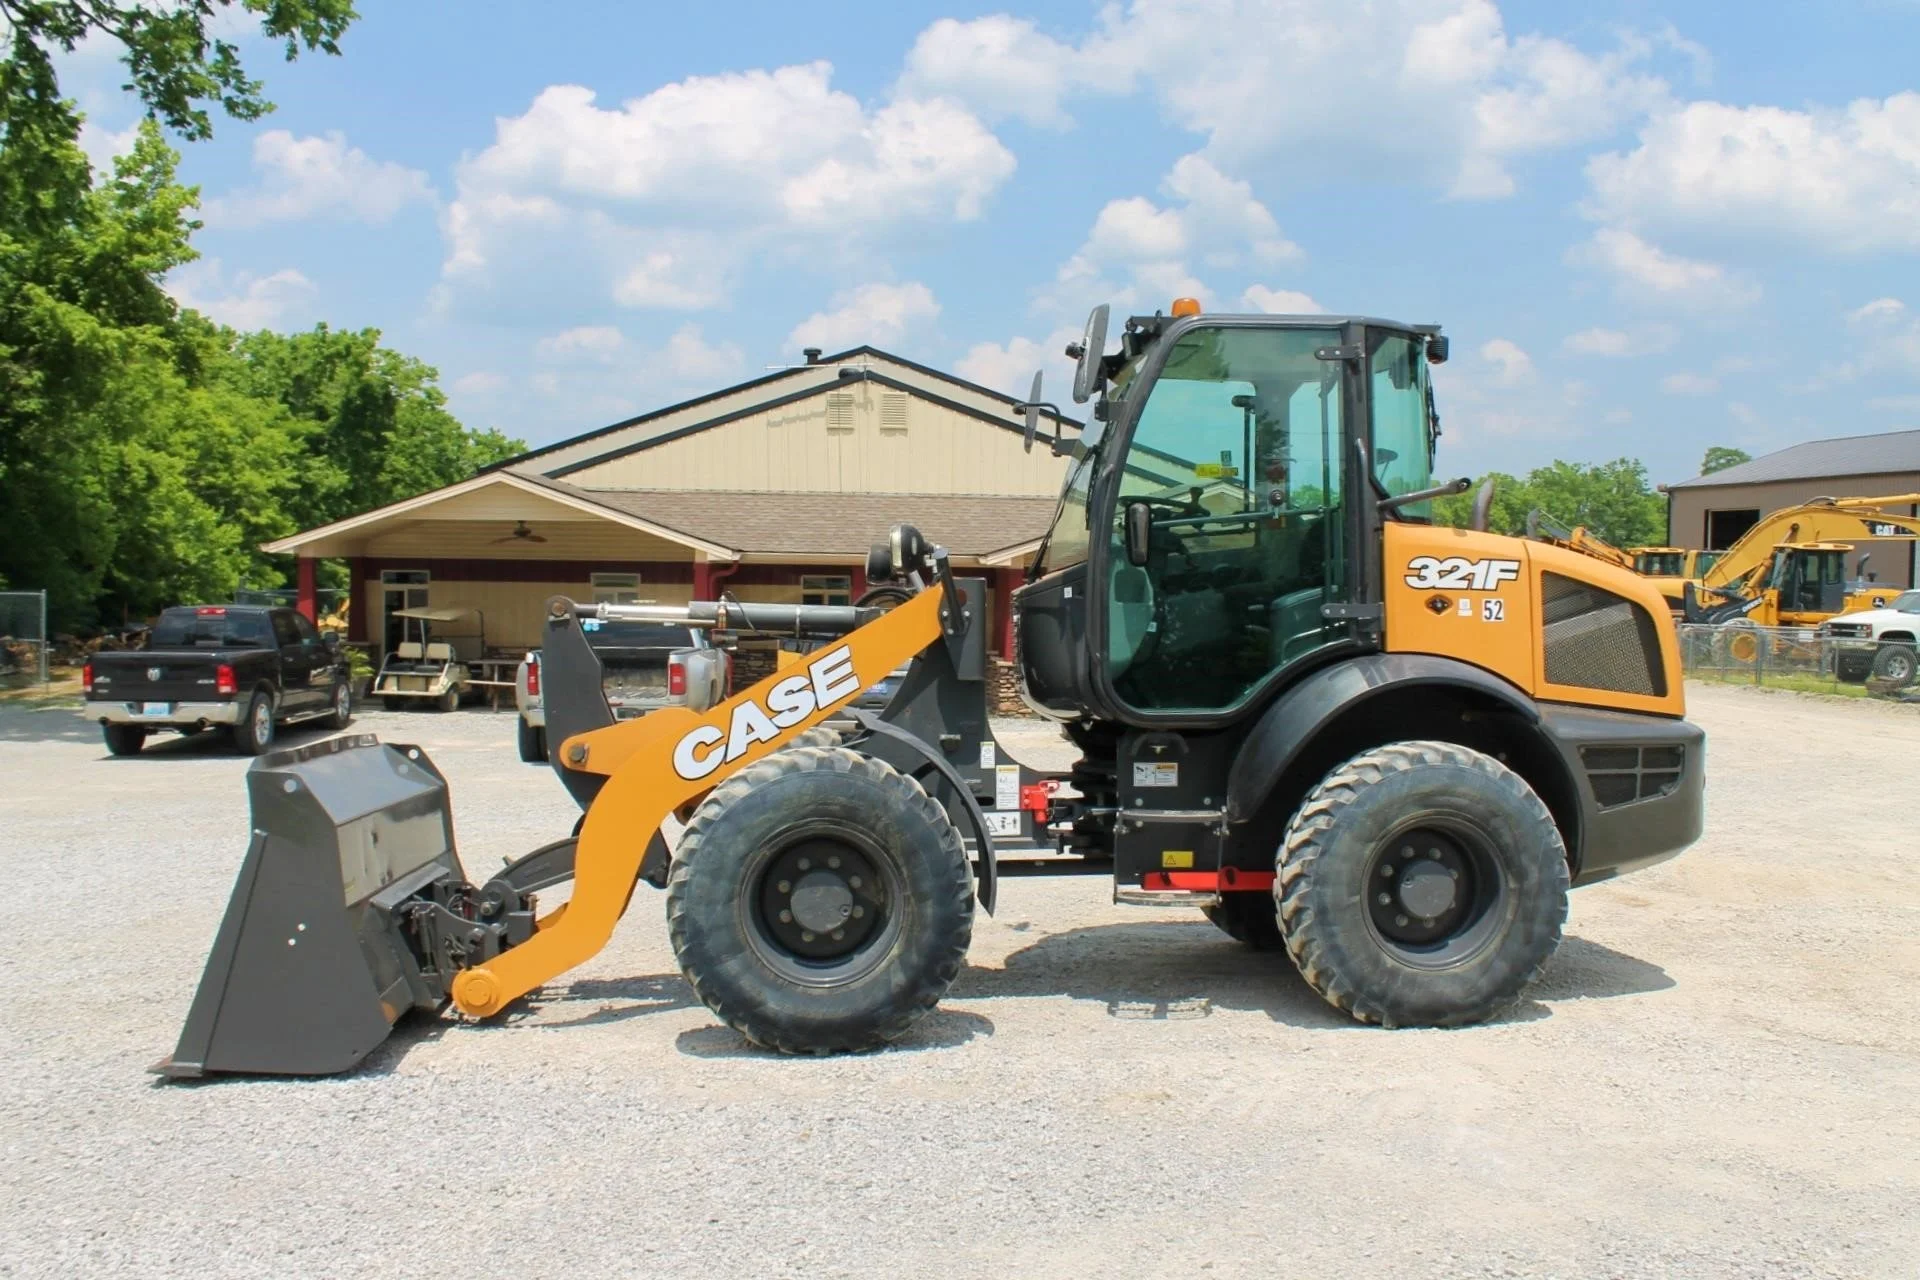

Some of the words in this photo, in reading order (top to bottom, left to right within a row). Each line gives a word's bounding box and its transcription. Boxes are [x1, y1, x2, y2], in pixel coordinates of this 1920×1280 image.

[1876, 524, 1895, 535] CAT
[1404, 556, 1520, 591] 321F
[1484, 600, 1503, 620] 52
[673, 645, 860, 780] CASE
